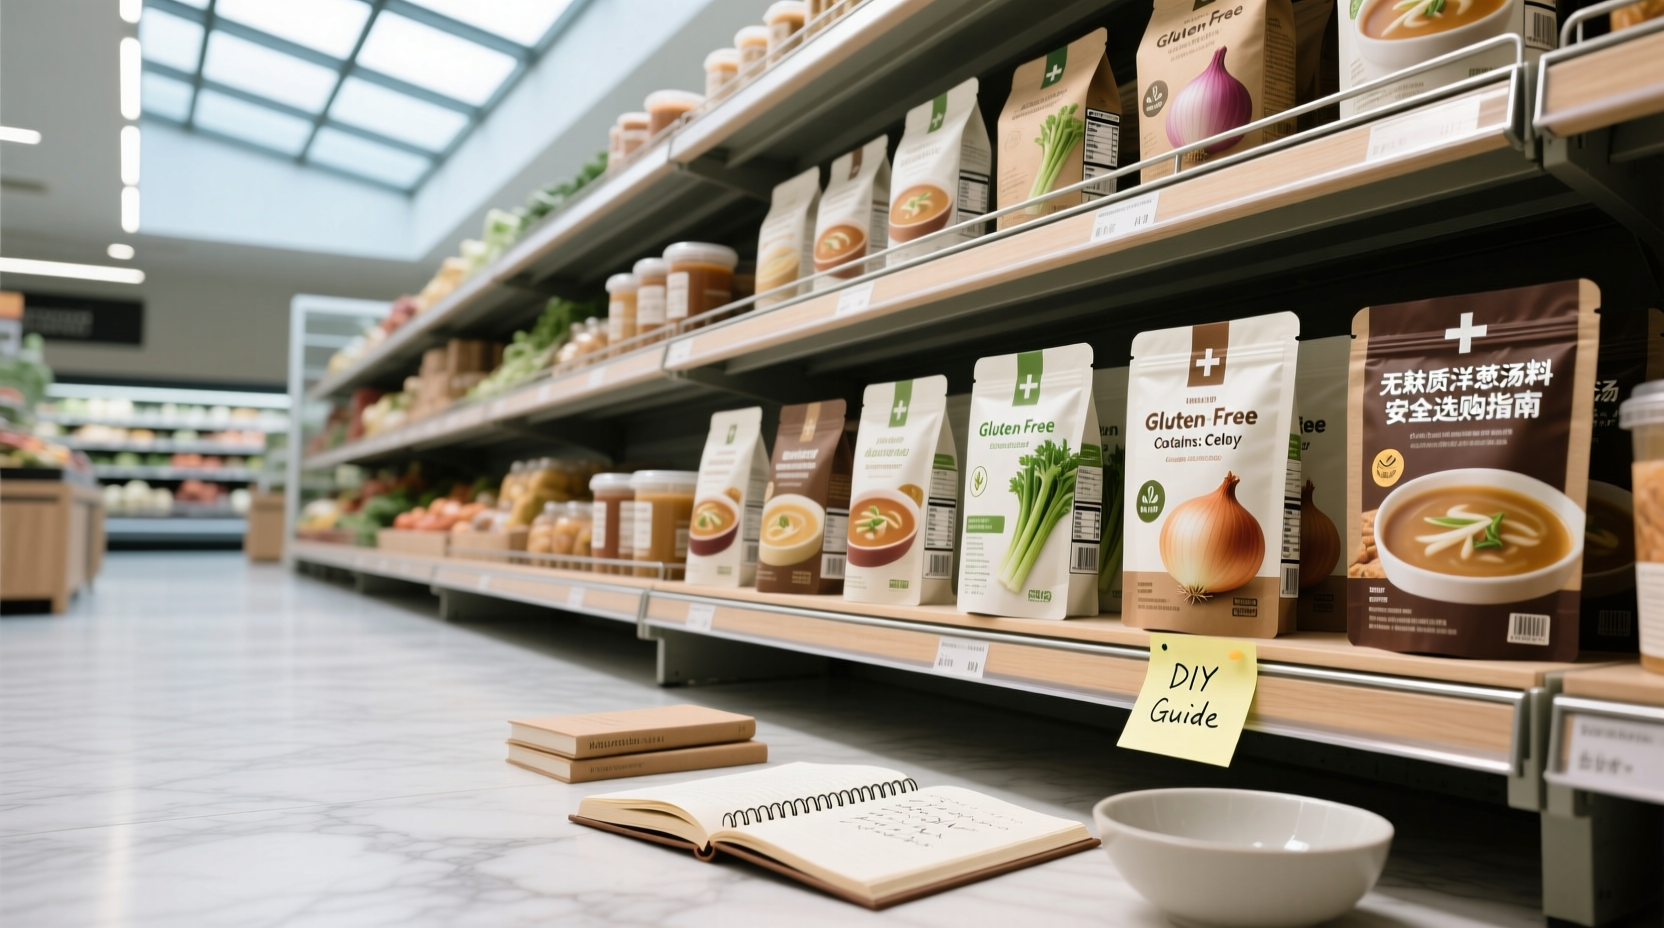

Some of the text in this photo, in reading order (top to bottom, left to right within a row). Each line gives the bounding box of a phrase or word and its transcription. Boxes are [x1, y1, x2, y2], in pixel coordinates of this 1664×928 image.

[1385, 390, 1543, 425] 安全选购指南
[979, 418, 1055, 437] Gluten Free
[1169, 662, 1219, 692] DIY
[1150, 697, 1219, 729] Guide
